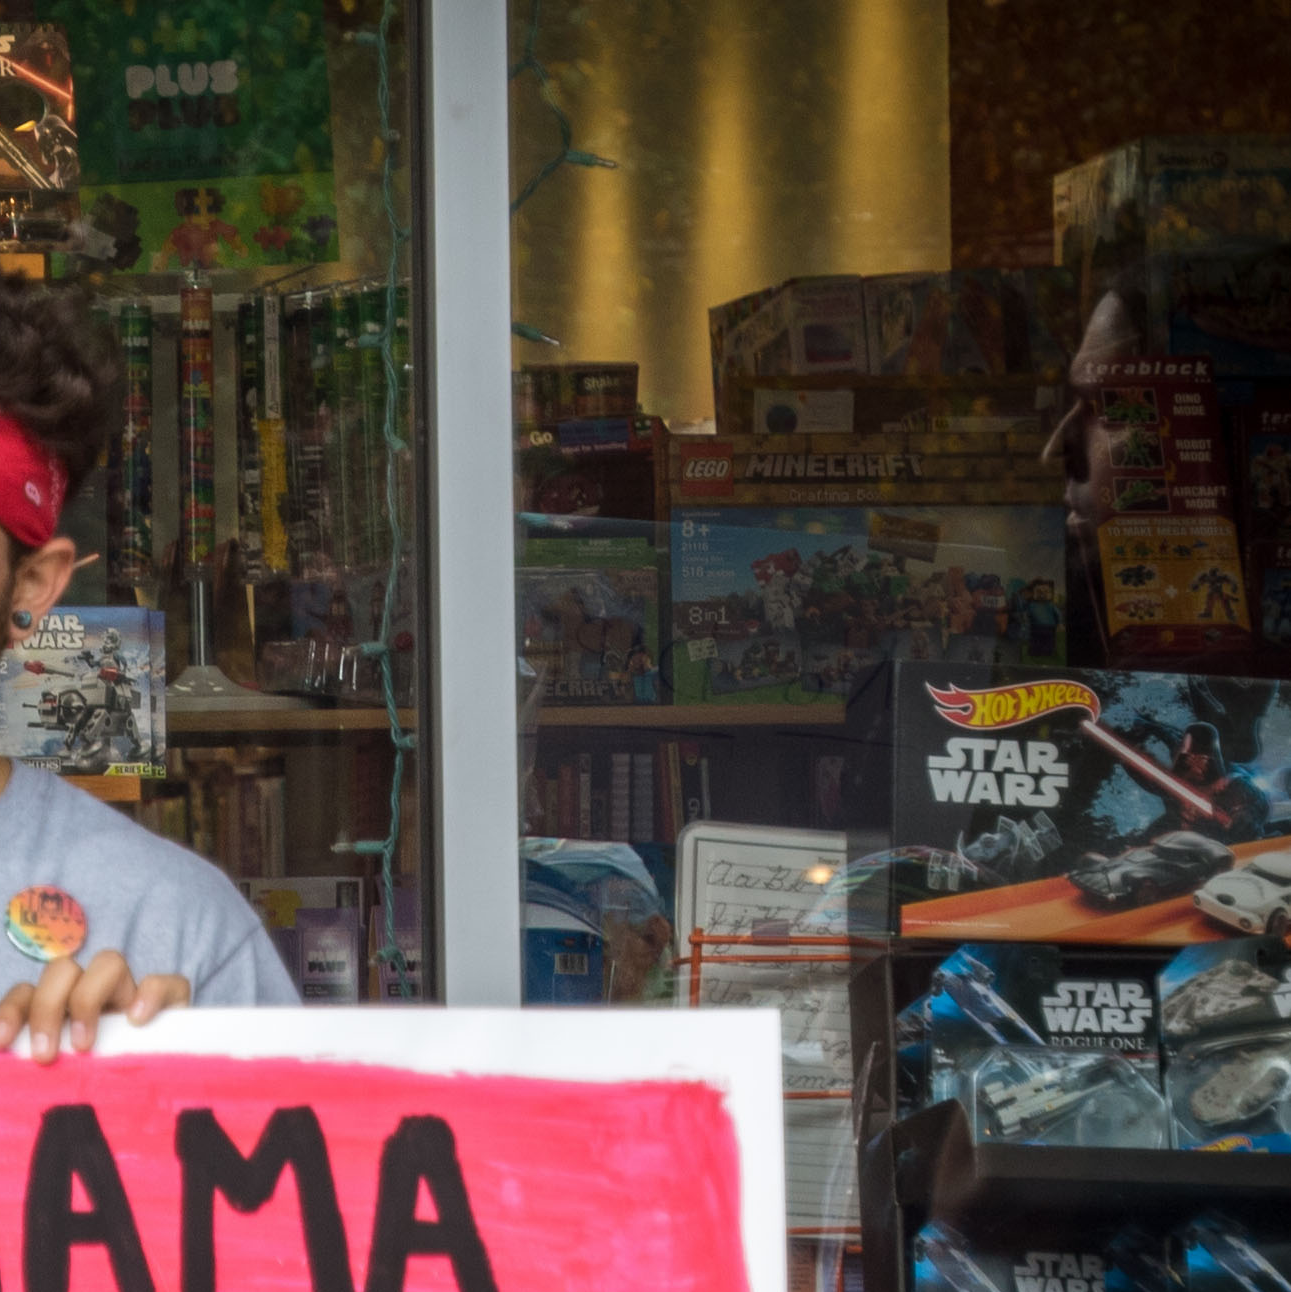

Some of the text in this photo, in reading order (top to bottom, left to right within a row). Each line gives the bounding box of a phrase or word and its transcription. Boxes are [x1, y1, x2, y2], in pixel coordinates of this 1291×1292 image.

[125, 59, 239, 99] PLUS
[1084, 359, 1210, 376] terablock
[684, 453, 925, 480] LEGO MINECRAFT
[788, 487, 851, 503] Crafting
[680, 520, 711, 538] 8+
[21, 631, 86, 650] WARS
[927, 736, 1070, 775] STAR
[114, 764, 141, 775] SERIES
[927, 768, 1070, 809] WARS
[1041, 980, 1154, 1008] STAR
[1041, 1006, 1154, 1034] WARS
[1109, 1036, 1147, 1051] ONE
[1013, 1251, 1107, 1279] STAR
